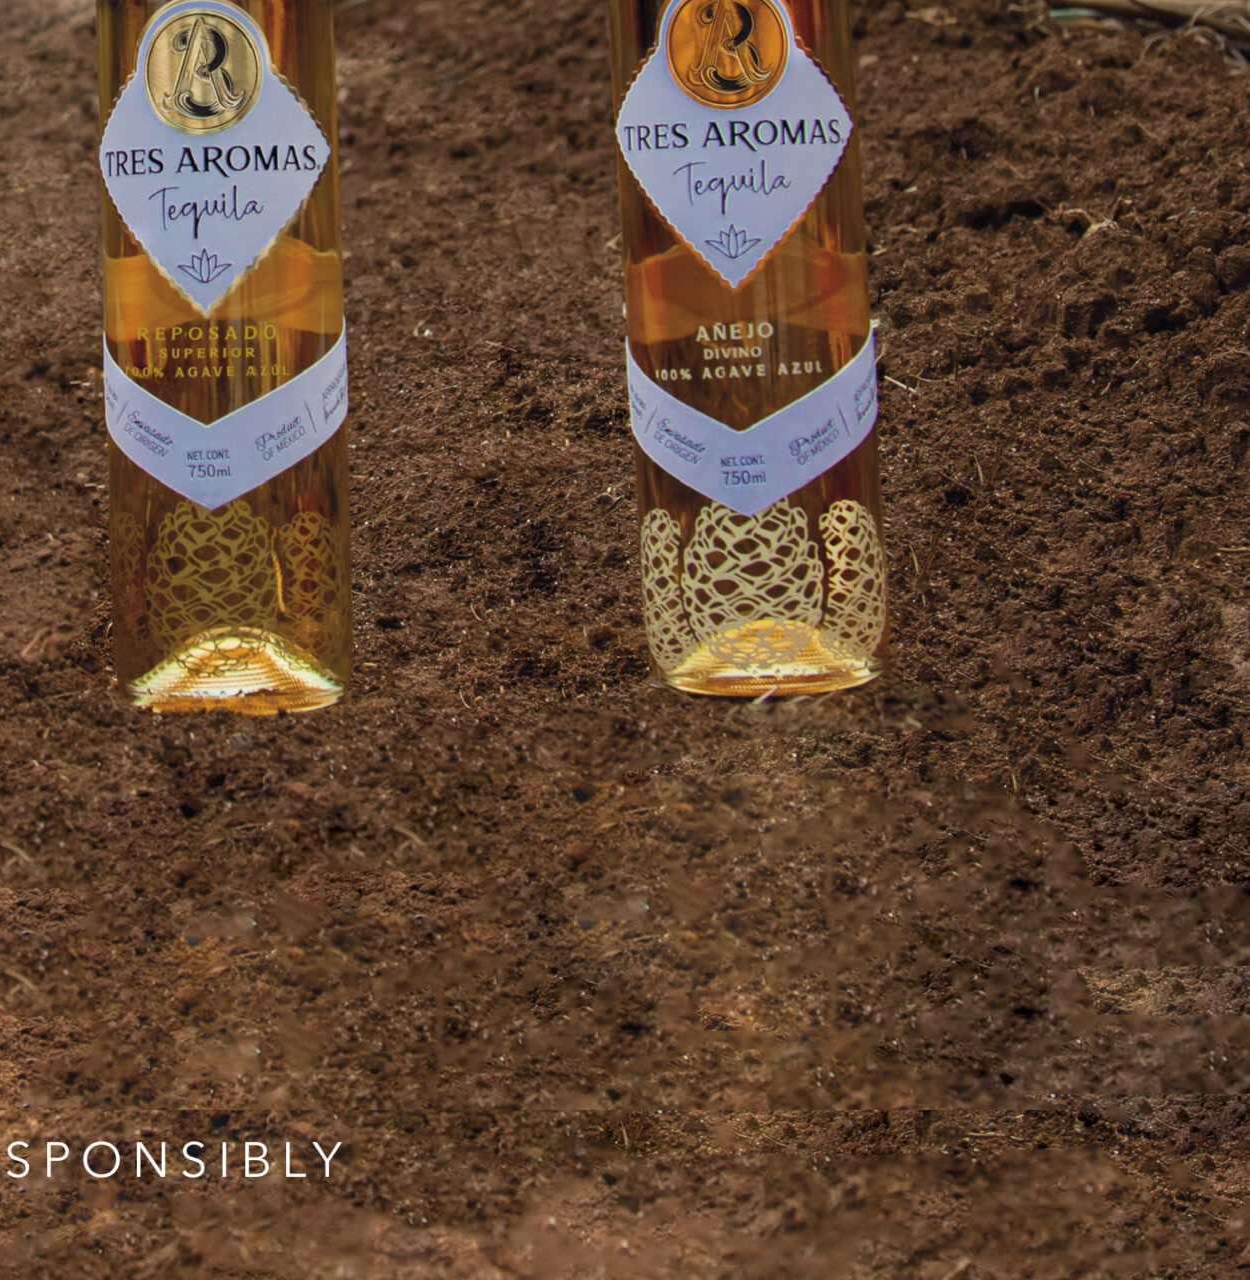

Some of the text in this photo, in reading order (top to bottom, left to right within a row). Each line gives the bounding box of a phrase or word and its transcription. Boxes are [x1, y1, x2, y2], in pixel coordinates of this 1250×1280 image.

[624, 123, 689, 151] TRES
[106, 148, 164, 177] TRES
[673, 160, 791, 215] Tequila
[148, 185, 264, 239] Tequila
[137, 324, 278, 340] REPOSADO
[696, 322, 774, 342] AÑEJO
[159, 347, 255, 358] SUPERIOR
[703, 346, 762, 360] DIVINO
[125, 366, 164, 378] 100%
[175, 366, 235, 378] AGAVE
[655, 361, 822, 381] 100% AGAVE AZUL
[128, 410, 174, 446] Envasado
[254, 415, 301, 453] Product
[134, 427, 169, 458] ORIGEN
[663, 437, 701, 465] ORIGEN
[263, 449, 276, 462] OF
[797, 452, 810, 465] OF
[187, 464, 231, 478] 750ml
[721, 471, 766, 485] 750ml
